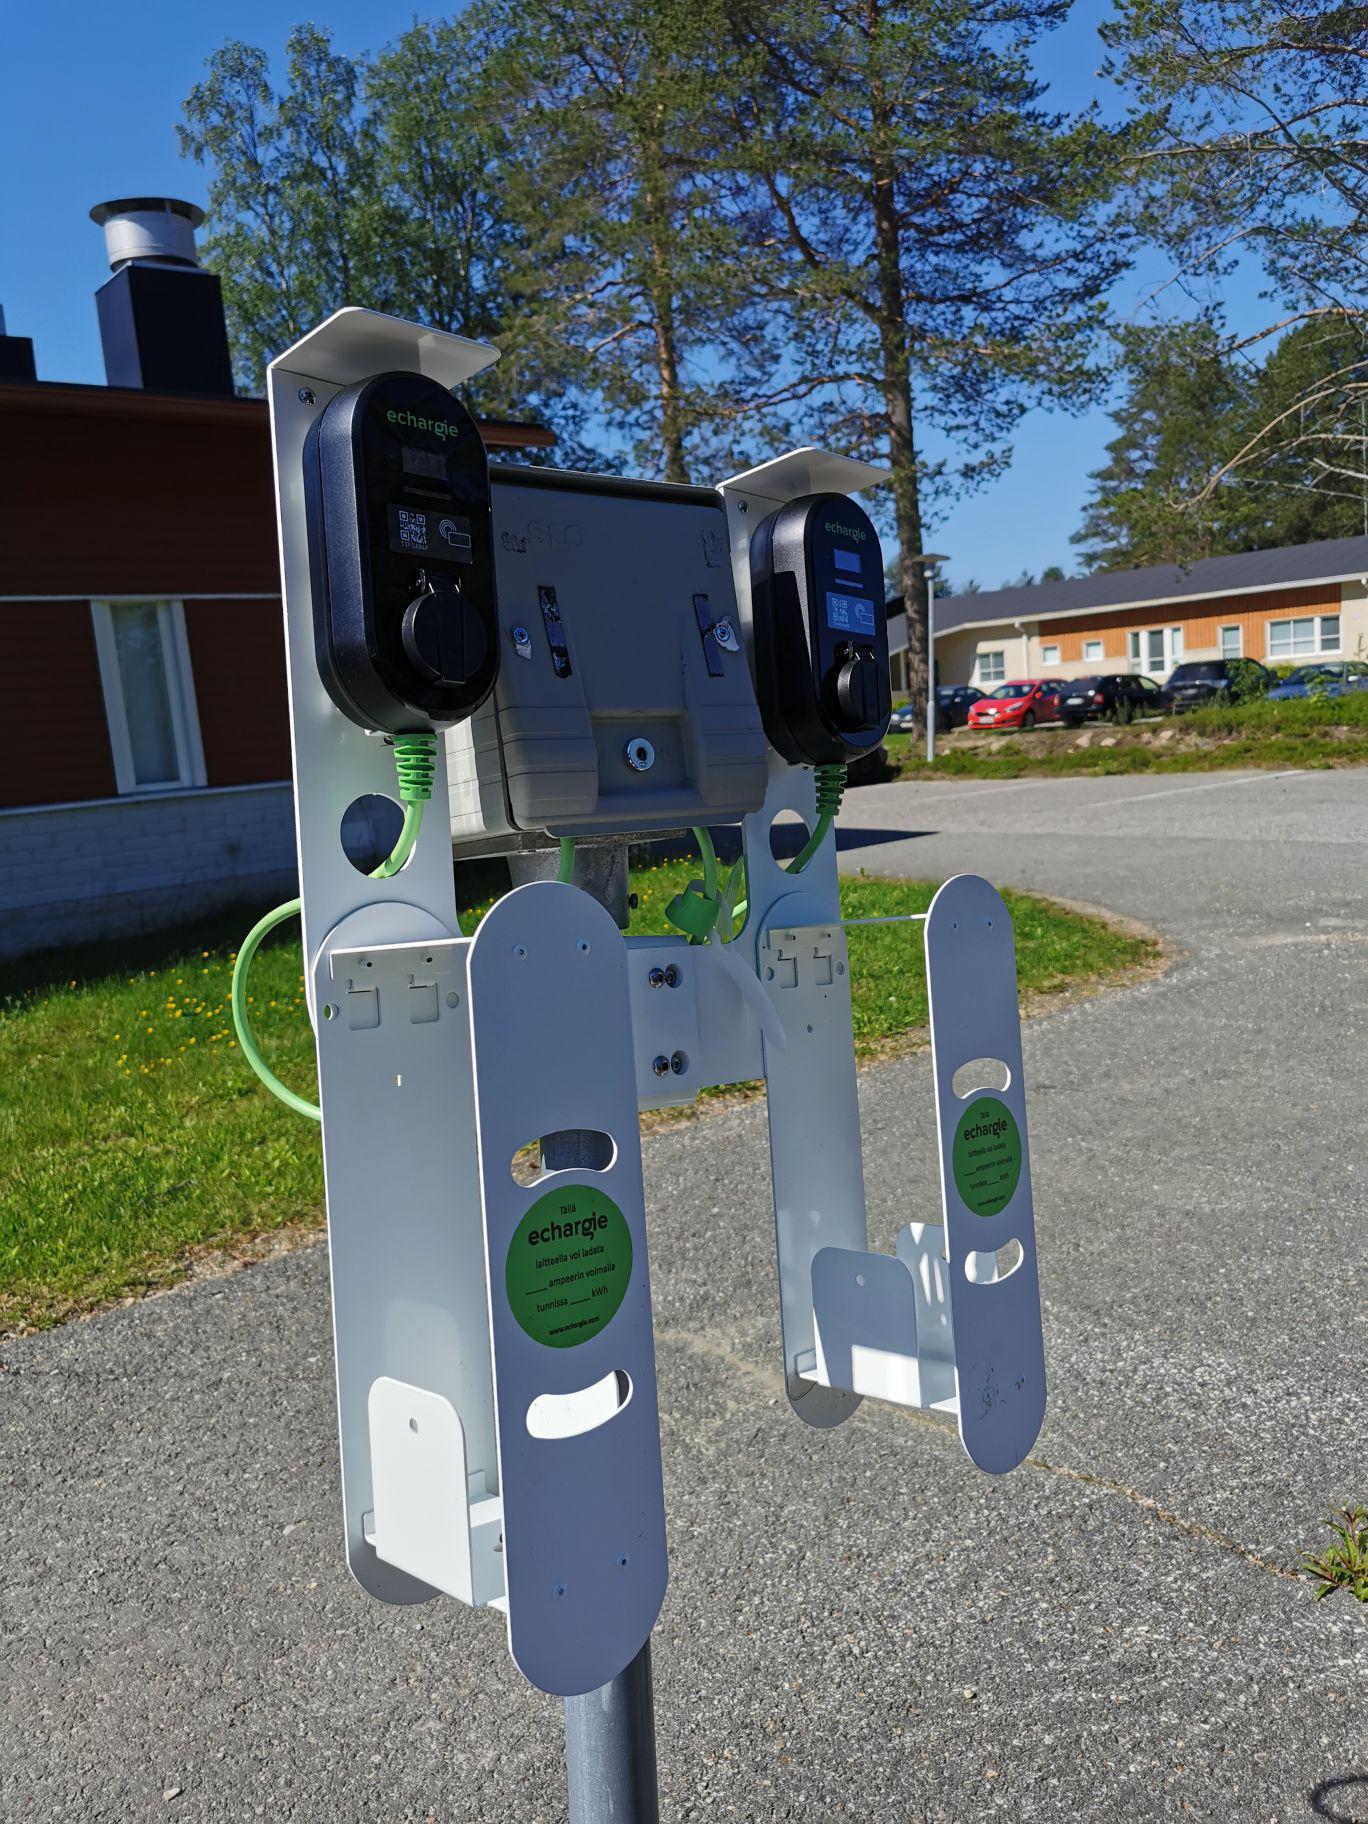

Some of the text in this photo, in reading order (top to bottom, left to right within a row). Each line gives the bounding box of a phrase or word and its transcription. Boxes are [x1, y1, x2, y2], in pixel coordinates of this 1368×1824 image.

[386, 410, 459, 442] echargie
[824, 521, 866, 544] echargie
[963, 1117, 1008, 1141] echargie
[528, 1211, 609, 1246] echargie
[582, 1245, 605, 1258] ladata
[548, 1271, 585, 1289] ampeerin
[536, 1286, 609, 1313] tunnissa kWh
